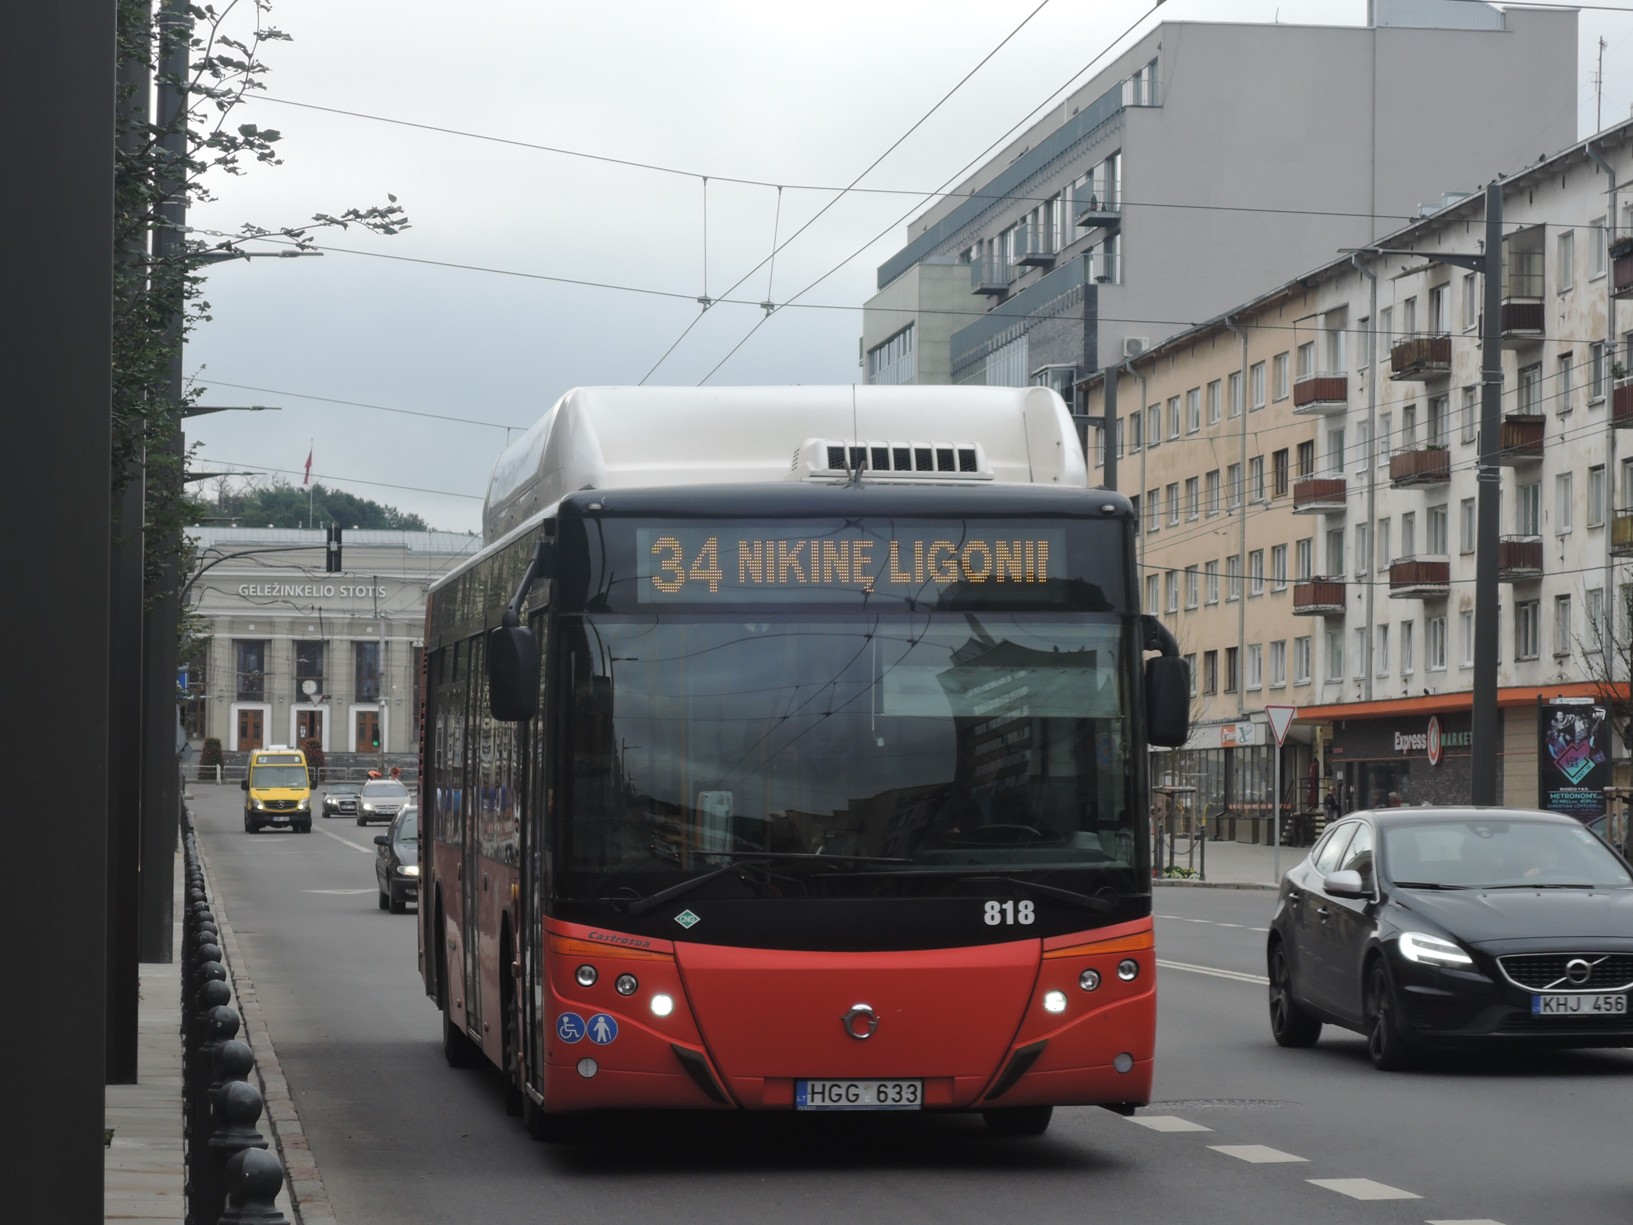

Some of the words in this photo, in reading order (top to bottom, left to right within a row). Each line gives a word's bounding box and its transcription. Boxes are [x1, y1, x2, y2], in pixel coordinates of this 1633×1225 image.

[651, 537, 723, 593] 34
[238, 582, 335, 597] GELEŽINKELIO
[340, 585, 387, 598] STOTIS
[1394, 731, 1427, 754] Express
[679, 915, 695, 923] CNG
[984, 900, 1035, 926] 818
[588, 931, 651, 948] Castrosua
[1543, 997, 1581, 1012] KHJ
[1592, 996, 1625, 1012] 456
[810, 1083, 860, 1103] HGG
[876, 1083, 918, 1103] 633
